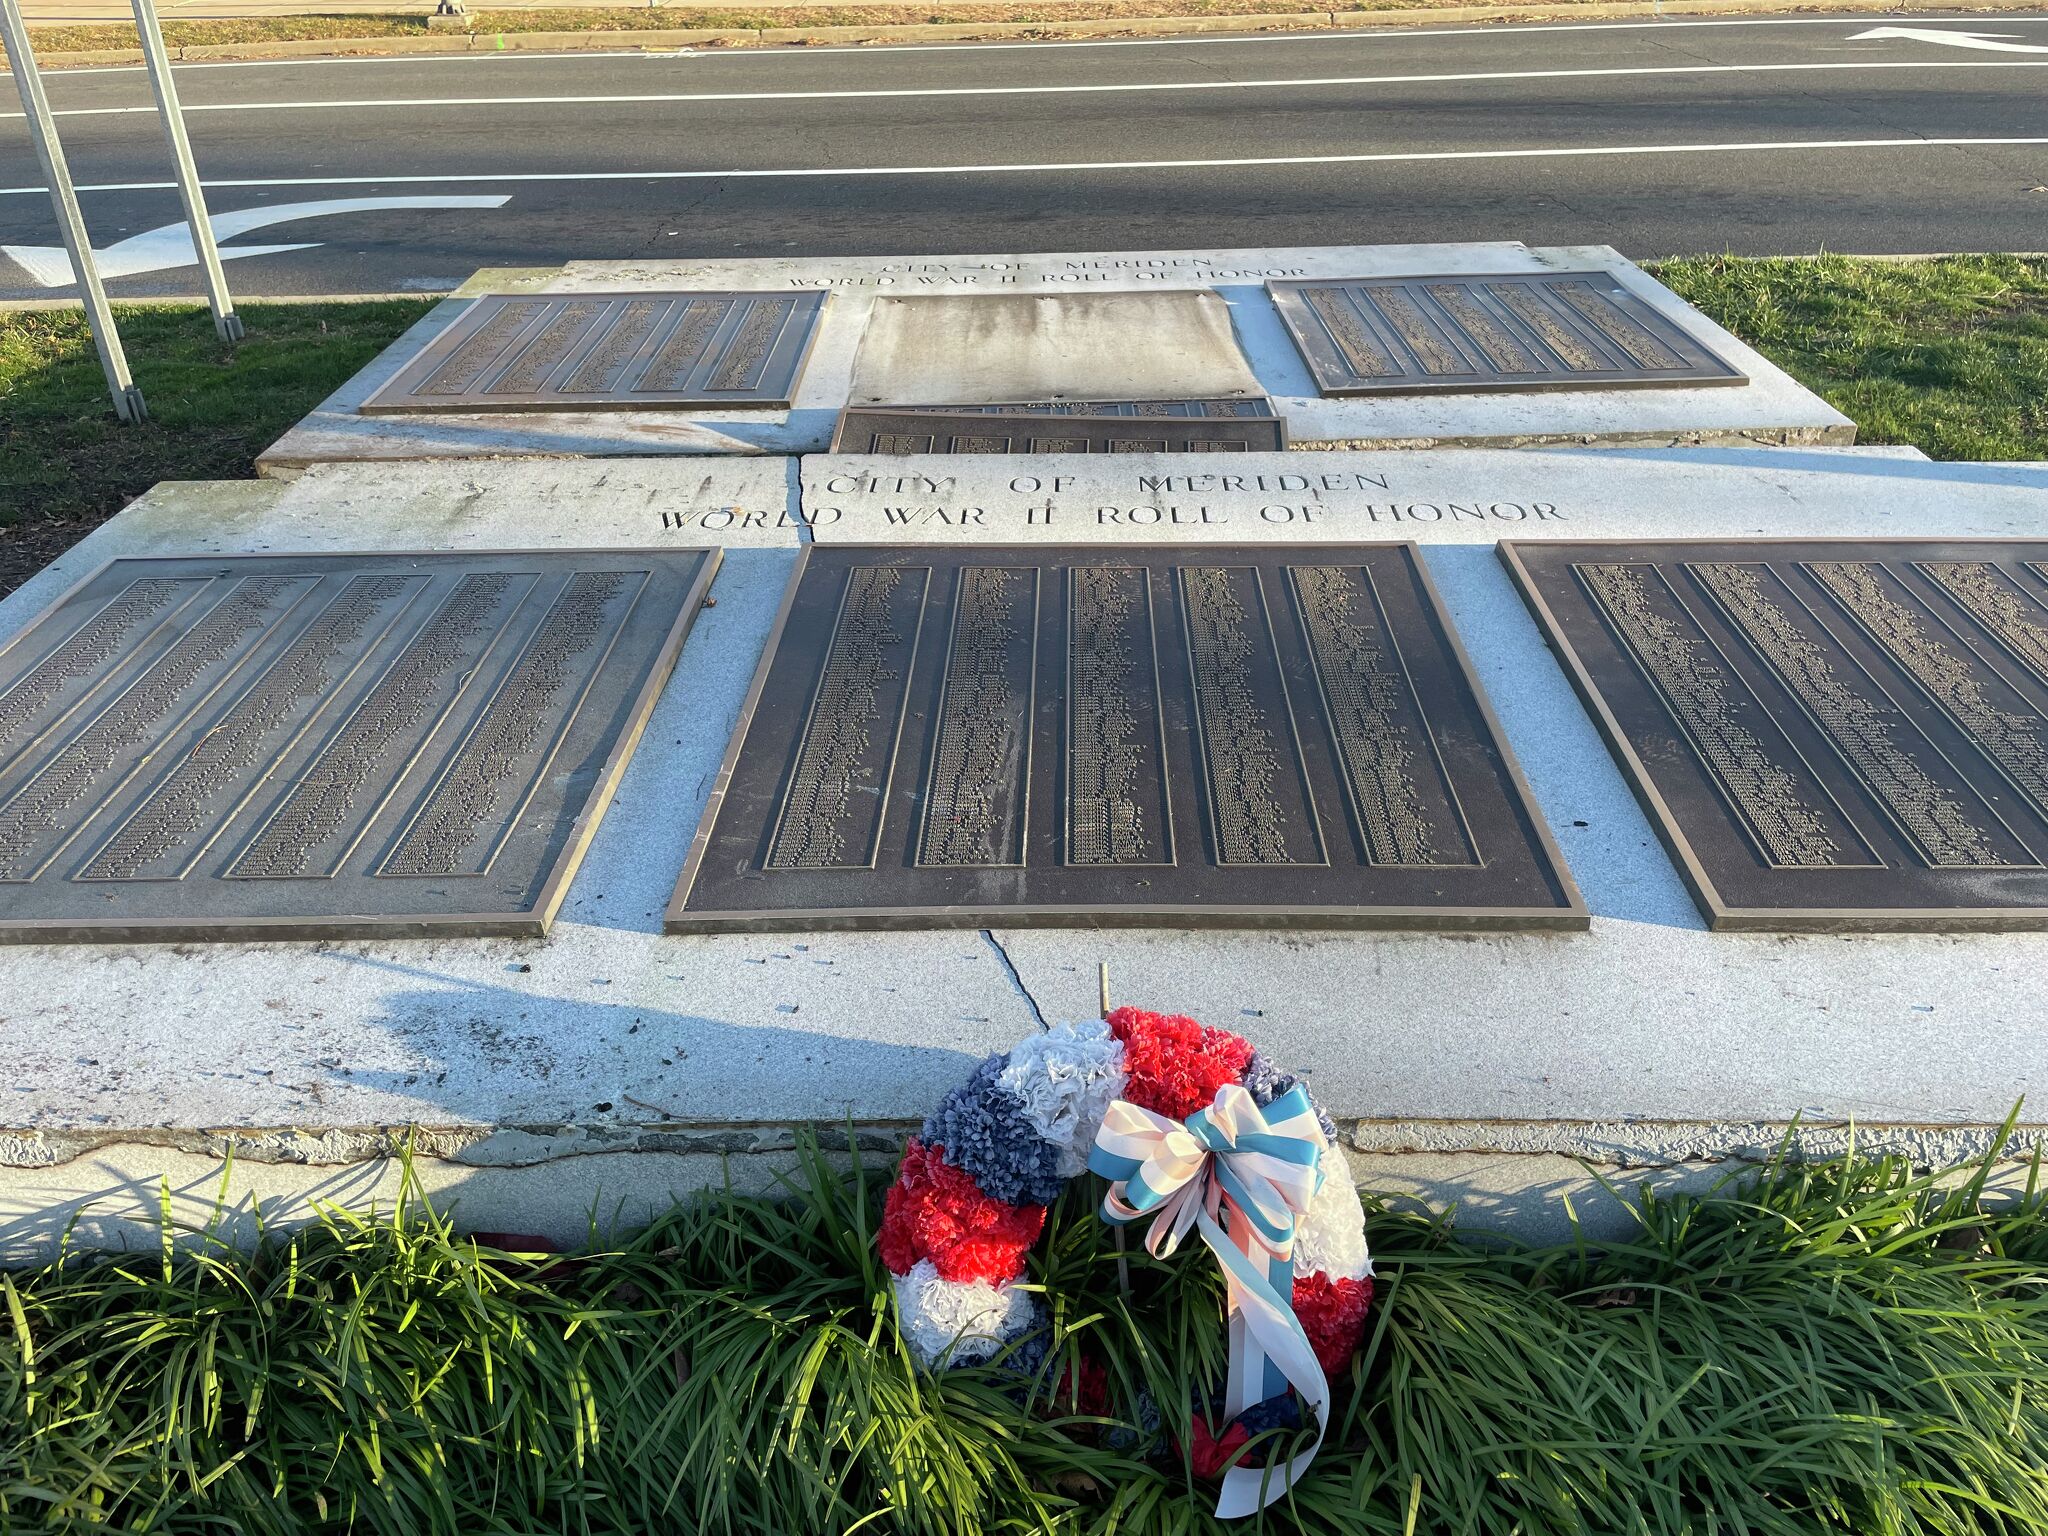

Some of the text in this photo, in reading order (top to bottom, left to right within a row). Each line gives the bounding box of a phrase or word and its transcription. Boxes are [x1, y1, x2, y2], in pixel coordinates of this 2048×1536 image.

[882, 258, 1212, 273] CITY OF MERIDEN
[790, 268, 1306, 287] WORLD WAR II ROLL OF HONOR
[826, 473, 1390, 494] CITY OF MERIDEN
[661, 502, 1569, 530] WORLD WAR II ROLL OF HONOR
